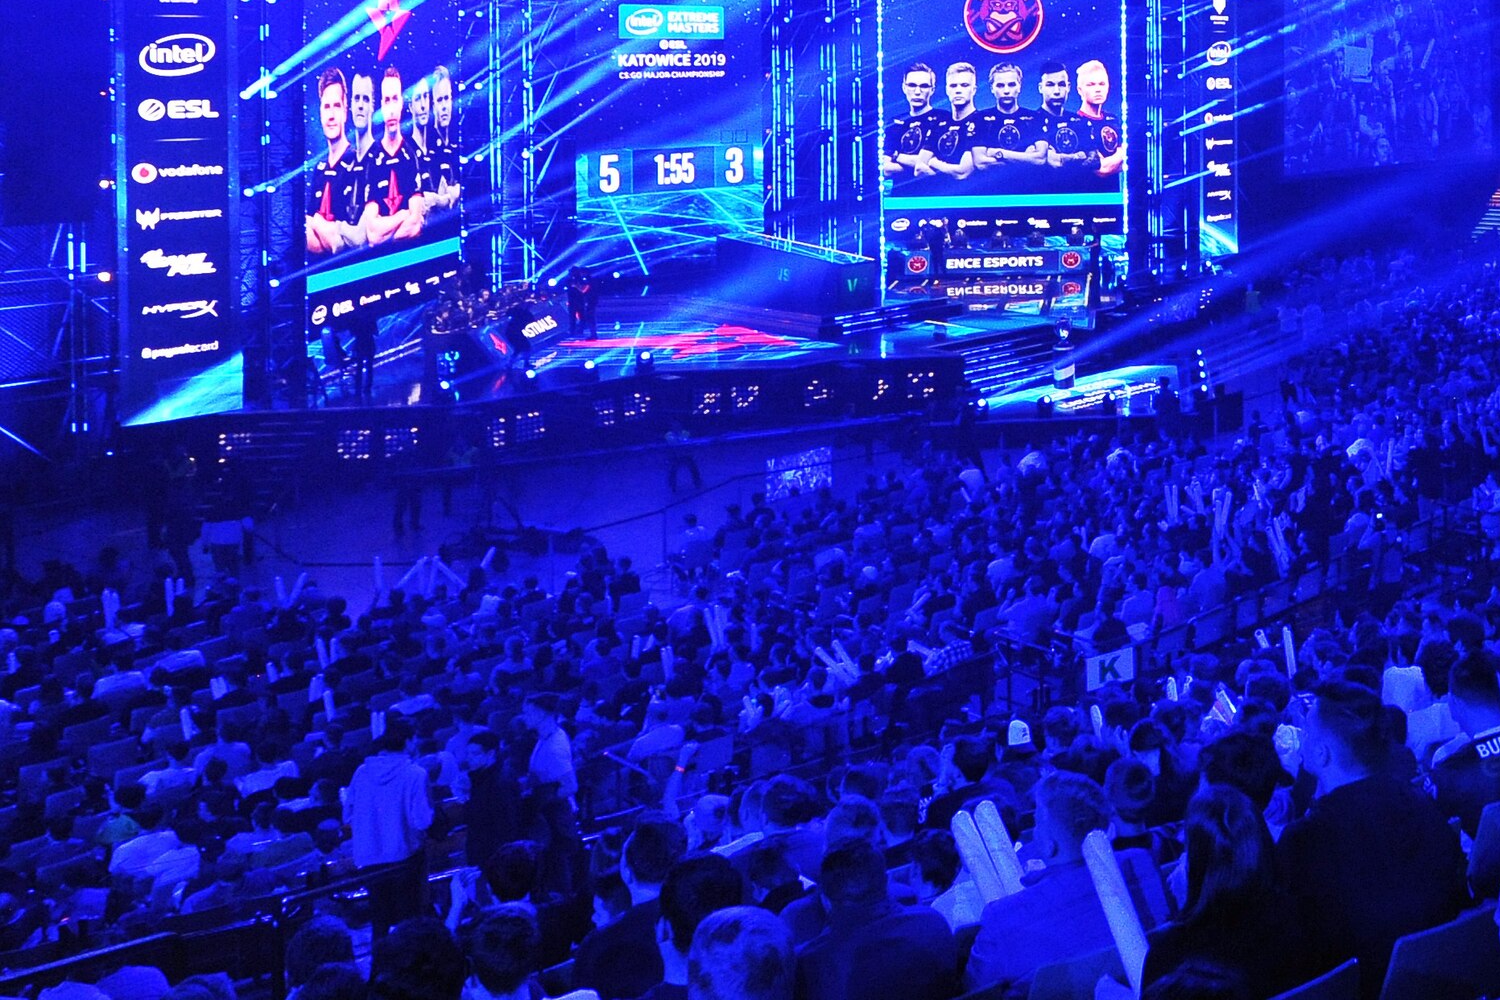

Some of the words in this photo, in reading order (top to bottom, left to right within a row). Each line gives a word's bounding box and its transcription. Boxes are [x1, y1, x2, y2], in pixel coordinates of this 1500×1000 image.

[667, 11, 719, 22] EXTREME
[667, 22, 719, 33] MASTERS
[618, 53, 691, 67] KATOWICE
[693, 53, 726, 66] 2019
[167, 99, 219, 119] ESL
[158, 164, 224, 177] vodafone
[599, 154, 620, 193] 5
[654, 152, 695, 185] 1:55
[724, 147, 744, 184] 3
[946, 257, 981, 269] ENCE
[983, 256, 1043, 268] ESPORTS
[1099, 655, 1121, 683] K
